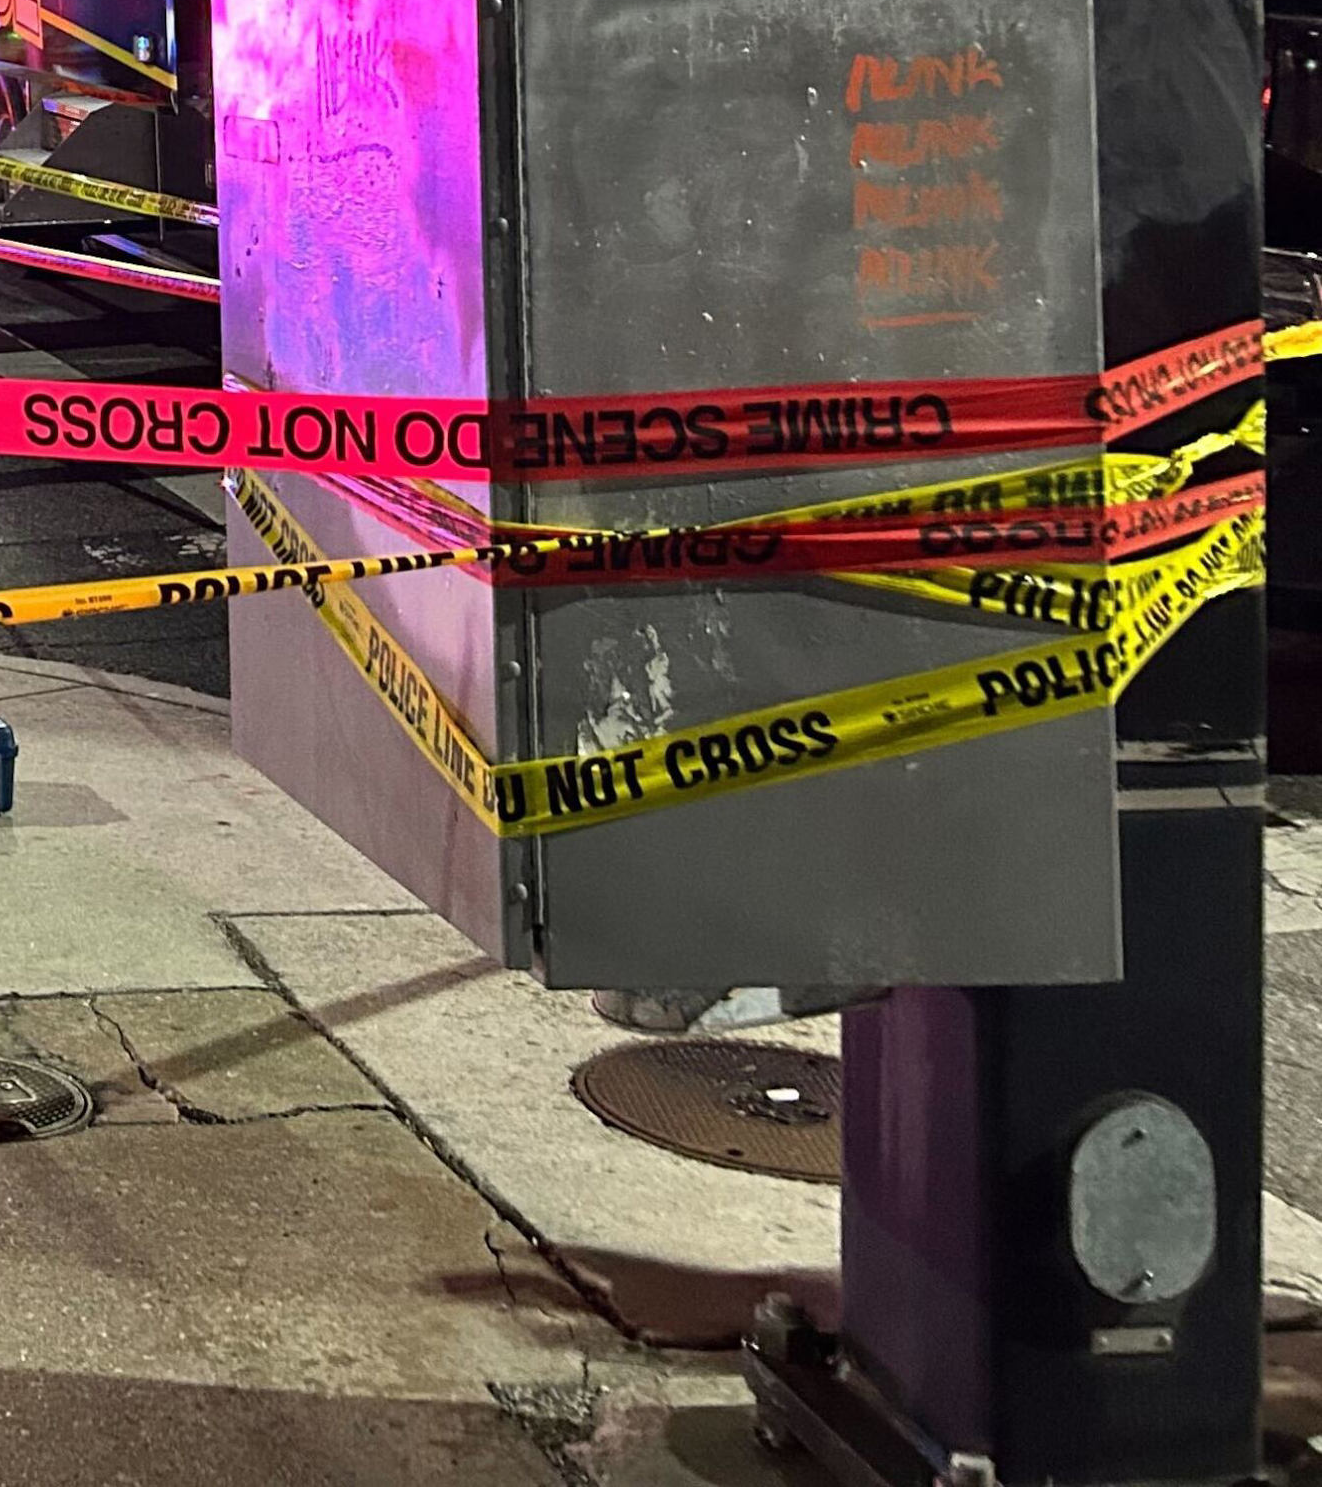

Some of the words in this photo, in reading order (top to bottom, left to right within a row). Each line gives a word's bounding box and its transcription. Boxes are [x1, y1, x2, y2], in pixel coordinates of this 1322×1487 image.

[23, 393, 230, 455] CROSS
[247, 406, 376, 465] NOT
[393, 410, 491, 470] DO
[512, 406, 729, 470] SCENE
[745, 393, 954, 455] CRIME
[157, 565, 333, 605] POLICE
[365, 624, 430, 739] POLICE
[433, 706, 477, 796] LINE
[545, 751, 644, 816] NOT
[663, 712, 839, 790] CROSS
[976, 634, 1132, 716] POLICE
